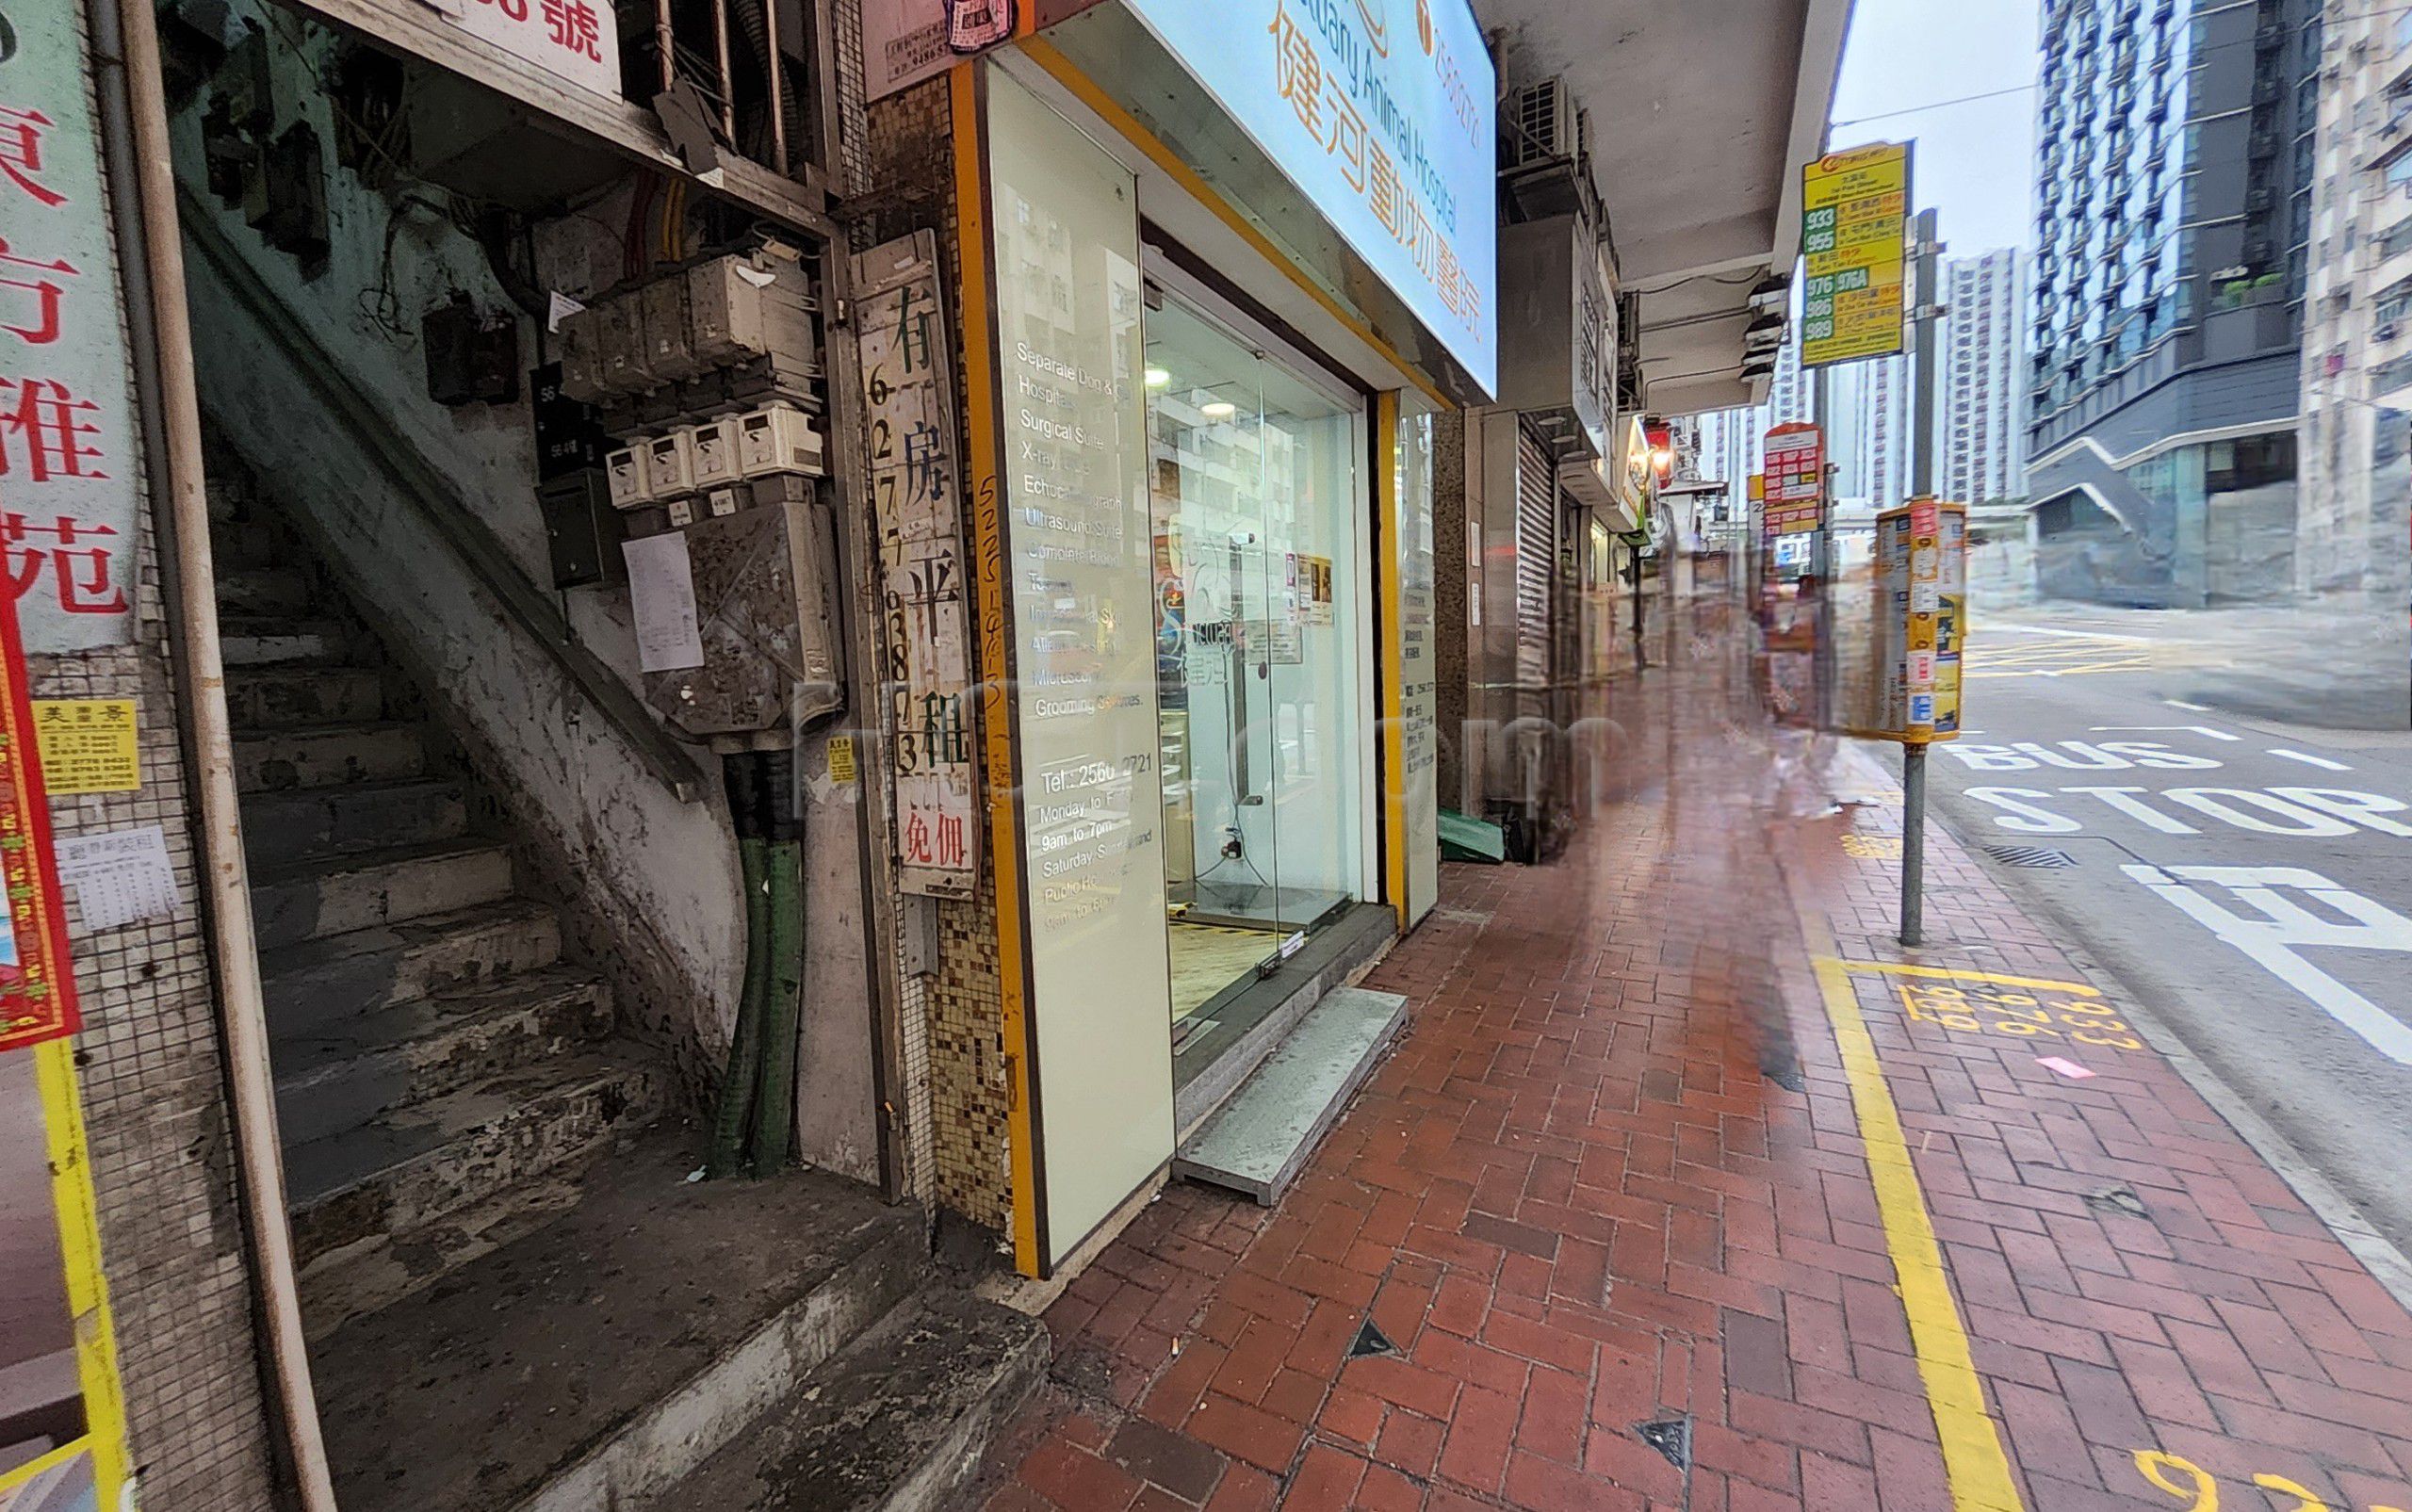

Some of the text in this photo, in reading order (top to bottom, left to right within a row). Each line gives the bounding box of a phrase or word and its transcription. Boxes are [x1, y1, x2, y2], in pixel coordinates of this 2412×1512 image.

[1363, 48, 1410, 168] Animal
[1414, 126, 1457, 238] Hospital
[1806, 207, 1834, 232] 933
[1807, 274, 1833, 298] 976
[1018, 342, 1075, 381] Separate
[1103, 379, 1113, 396] &
[1020, 409, 1072, 440] Surgical
[1022, 440, 1055, 470] X-ray
[1025, 506, 1123, 540] Ultrasound Suite
[1035, 698, 1095, 717] Grooming
[1122, 753, 1151, 776] 2721
[1941, 740, 2224, 771] BUS
[1040, 801, 1086, 825] Monday
[1090, 796, 1101, 810] to
[1962, 786, 2412, 837] STOP
[905, 811, 967, 868] 免佣
[1041, 819, 1113, 853] 9am to 7pm
